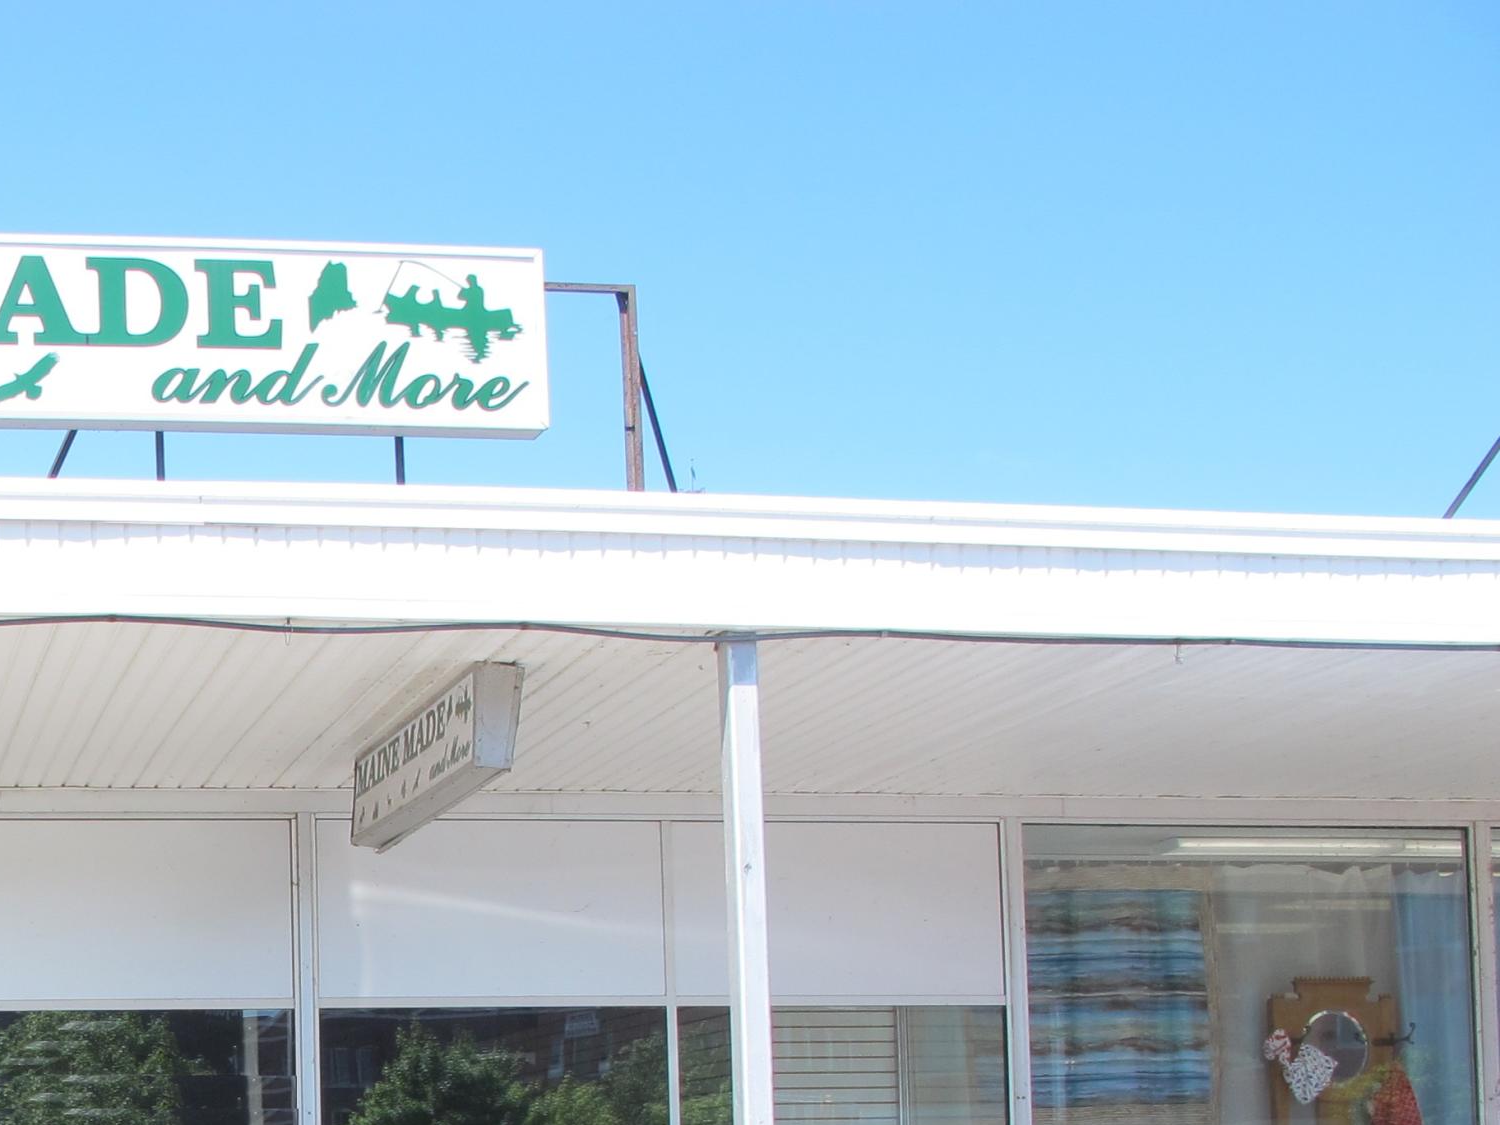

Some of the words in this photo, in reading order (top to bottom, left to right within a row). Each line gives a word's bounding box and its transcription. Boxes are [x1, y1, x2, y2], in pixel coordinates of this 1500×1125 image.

[151, 342, 324, 405] and
[320, 340, 530, 411] More
[356, 735, 400, 799] MAINE
[402, 699, 445, 766] MADE
